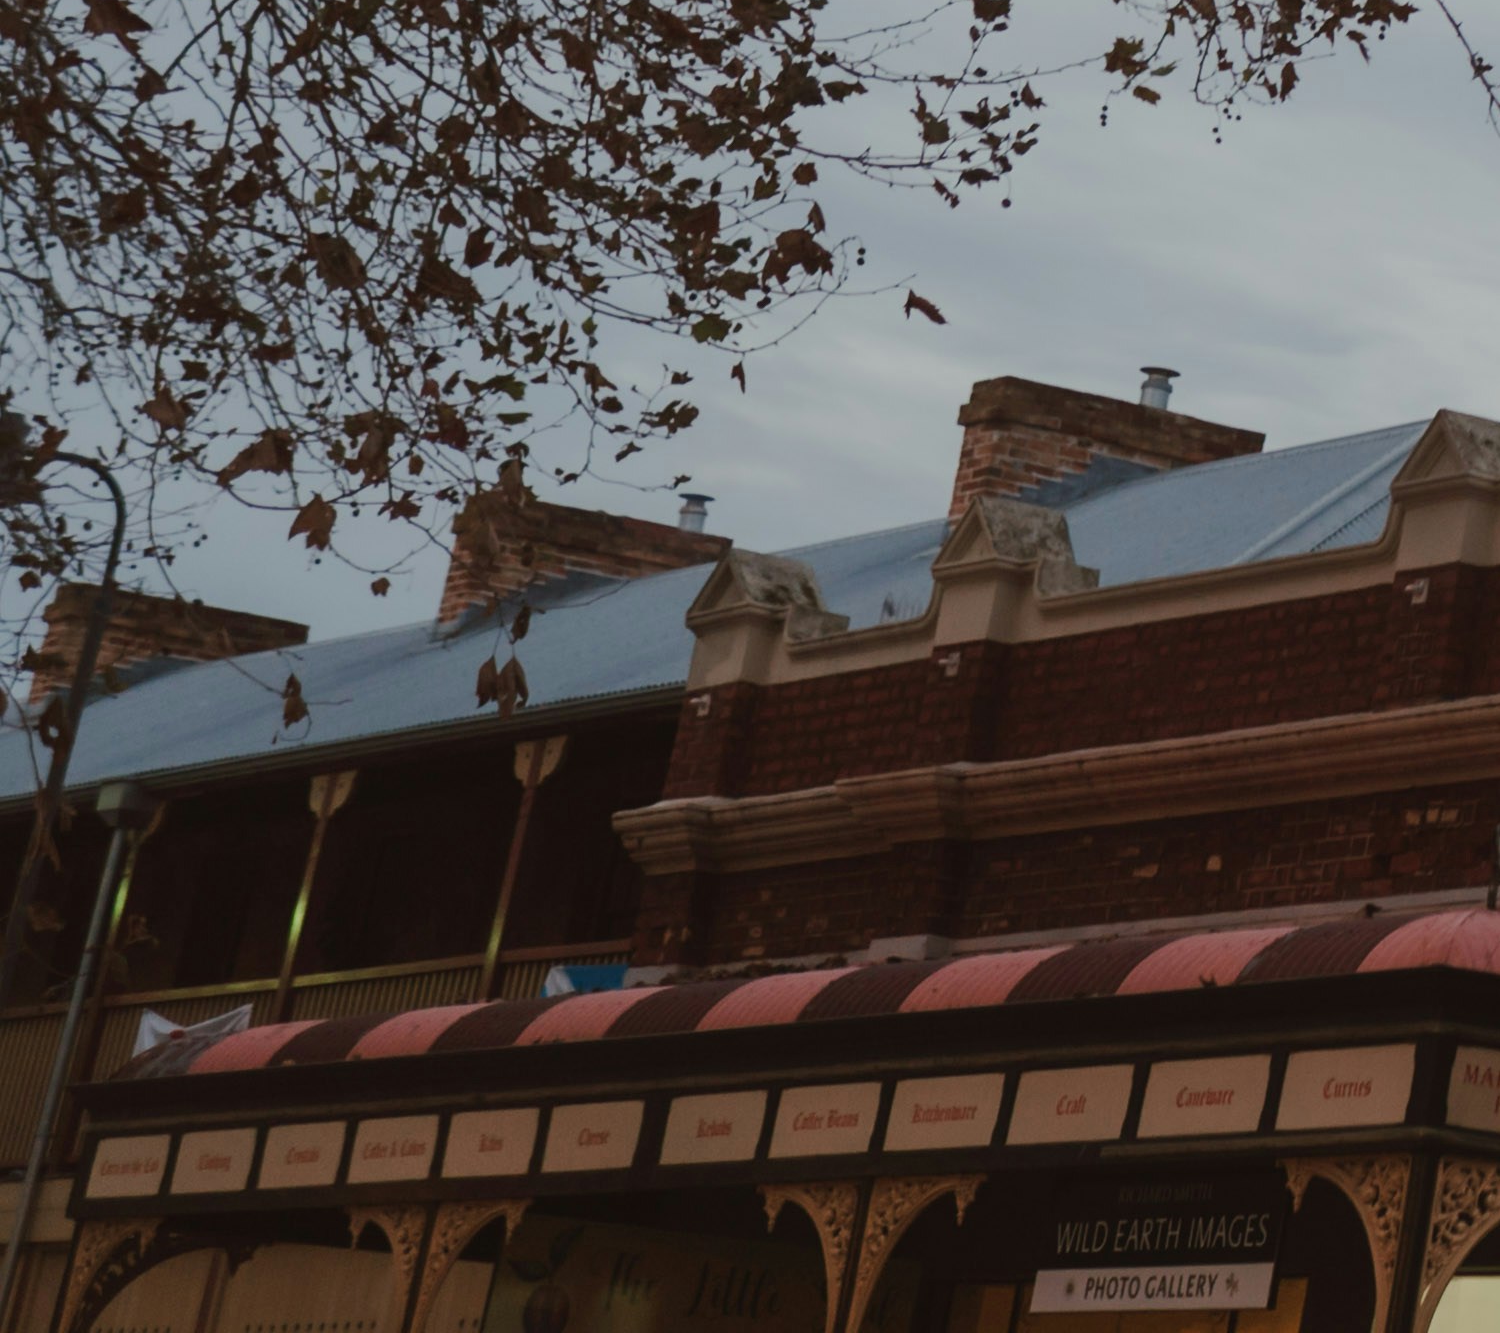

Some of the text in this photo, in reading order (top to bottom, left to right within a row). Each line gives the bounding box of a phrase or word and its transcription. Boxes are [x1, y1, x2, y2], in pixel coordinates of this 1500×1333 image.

[1175, 1086, 1236, 1109] Caneware
[1321, 1077, 1374, 1100] Curries
[911, 1101, 979, 1124] Kitchenware
[1055, 1093, 1087, 1116] Craft
[792, 1109, 860, 1132] Coffee Beans
[1056, 1213, 1271, 1255] WILD EARTH IMAGES
[1083, 1273, 1220, 1300] PHOTO GALLERY
